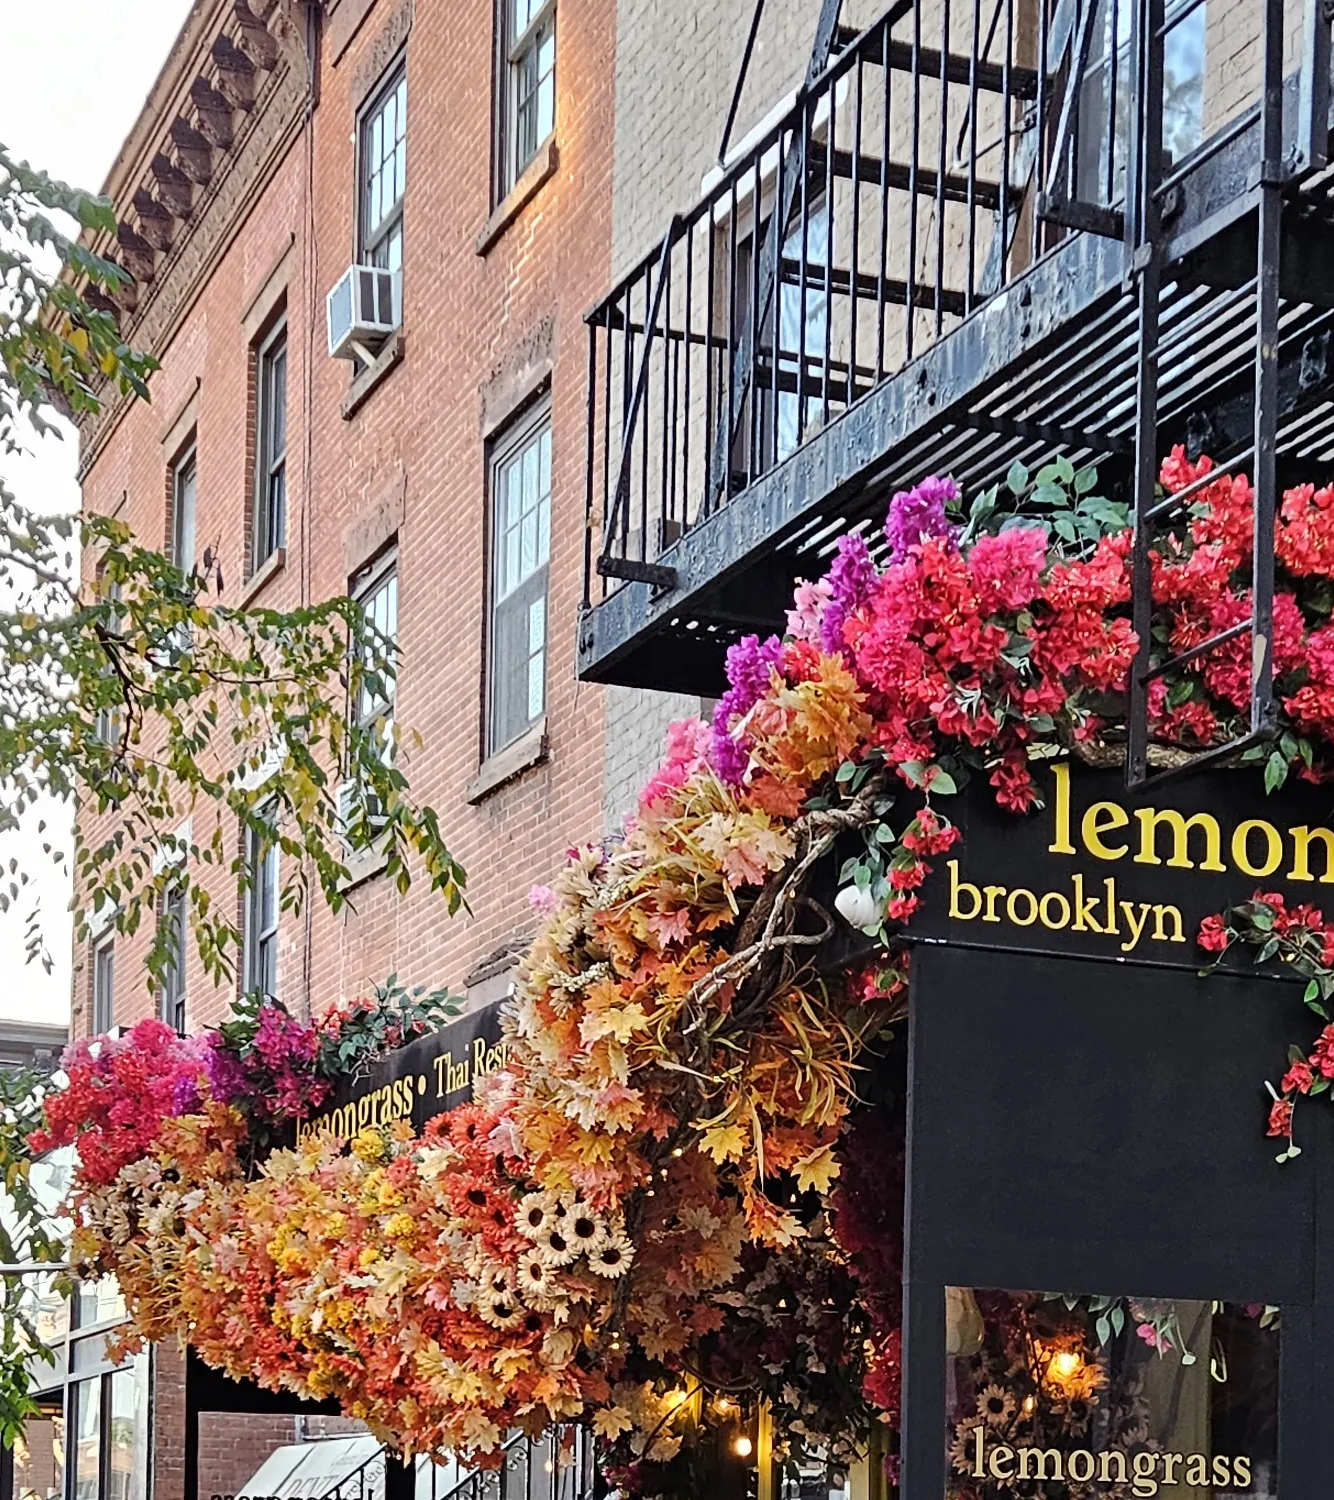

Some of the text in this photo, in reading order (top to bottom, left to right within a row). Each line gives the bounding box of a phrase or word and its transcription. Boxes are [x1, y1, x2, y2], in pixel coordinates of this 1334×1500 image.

[946, 859, 1187, 952] brooklyn
[433, 1043, 470, 1098] Thai
[473, 1037, 509, 1076] Rest
[971, 1425, 1252, 1498] lemongrass
